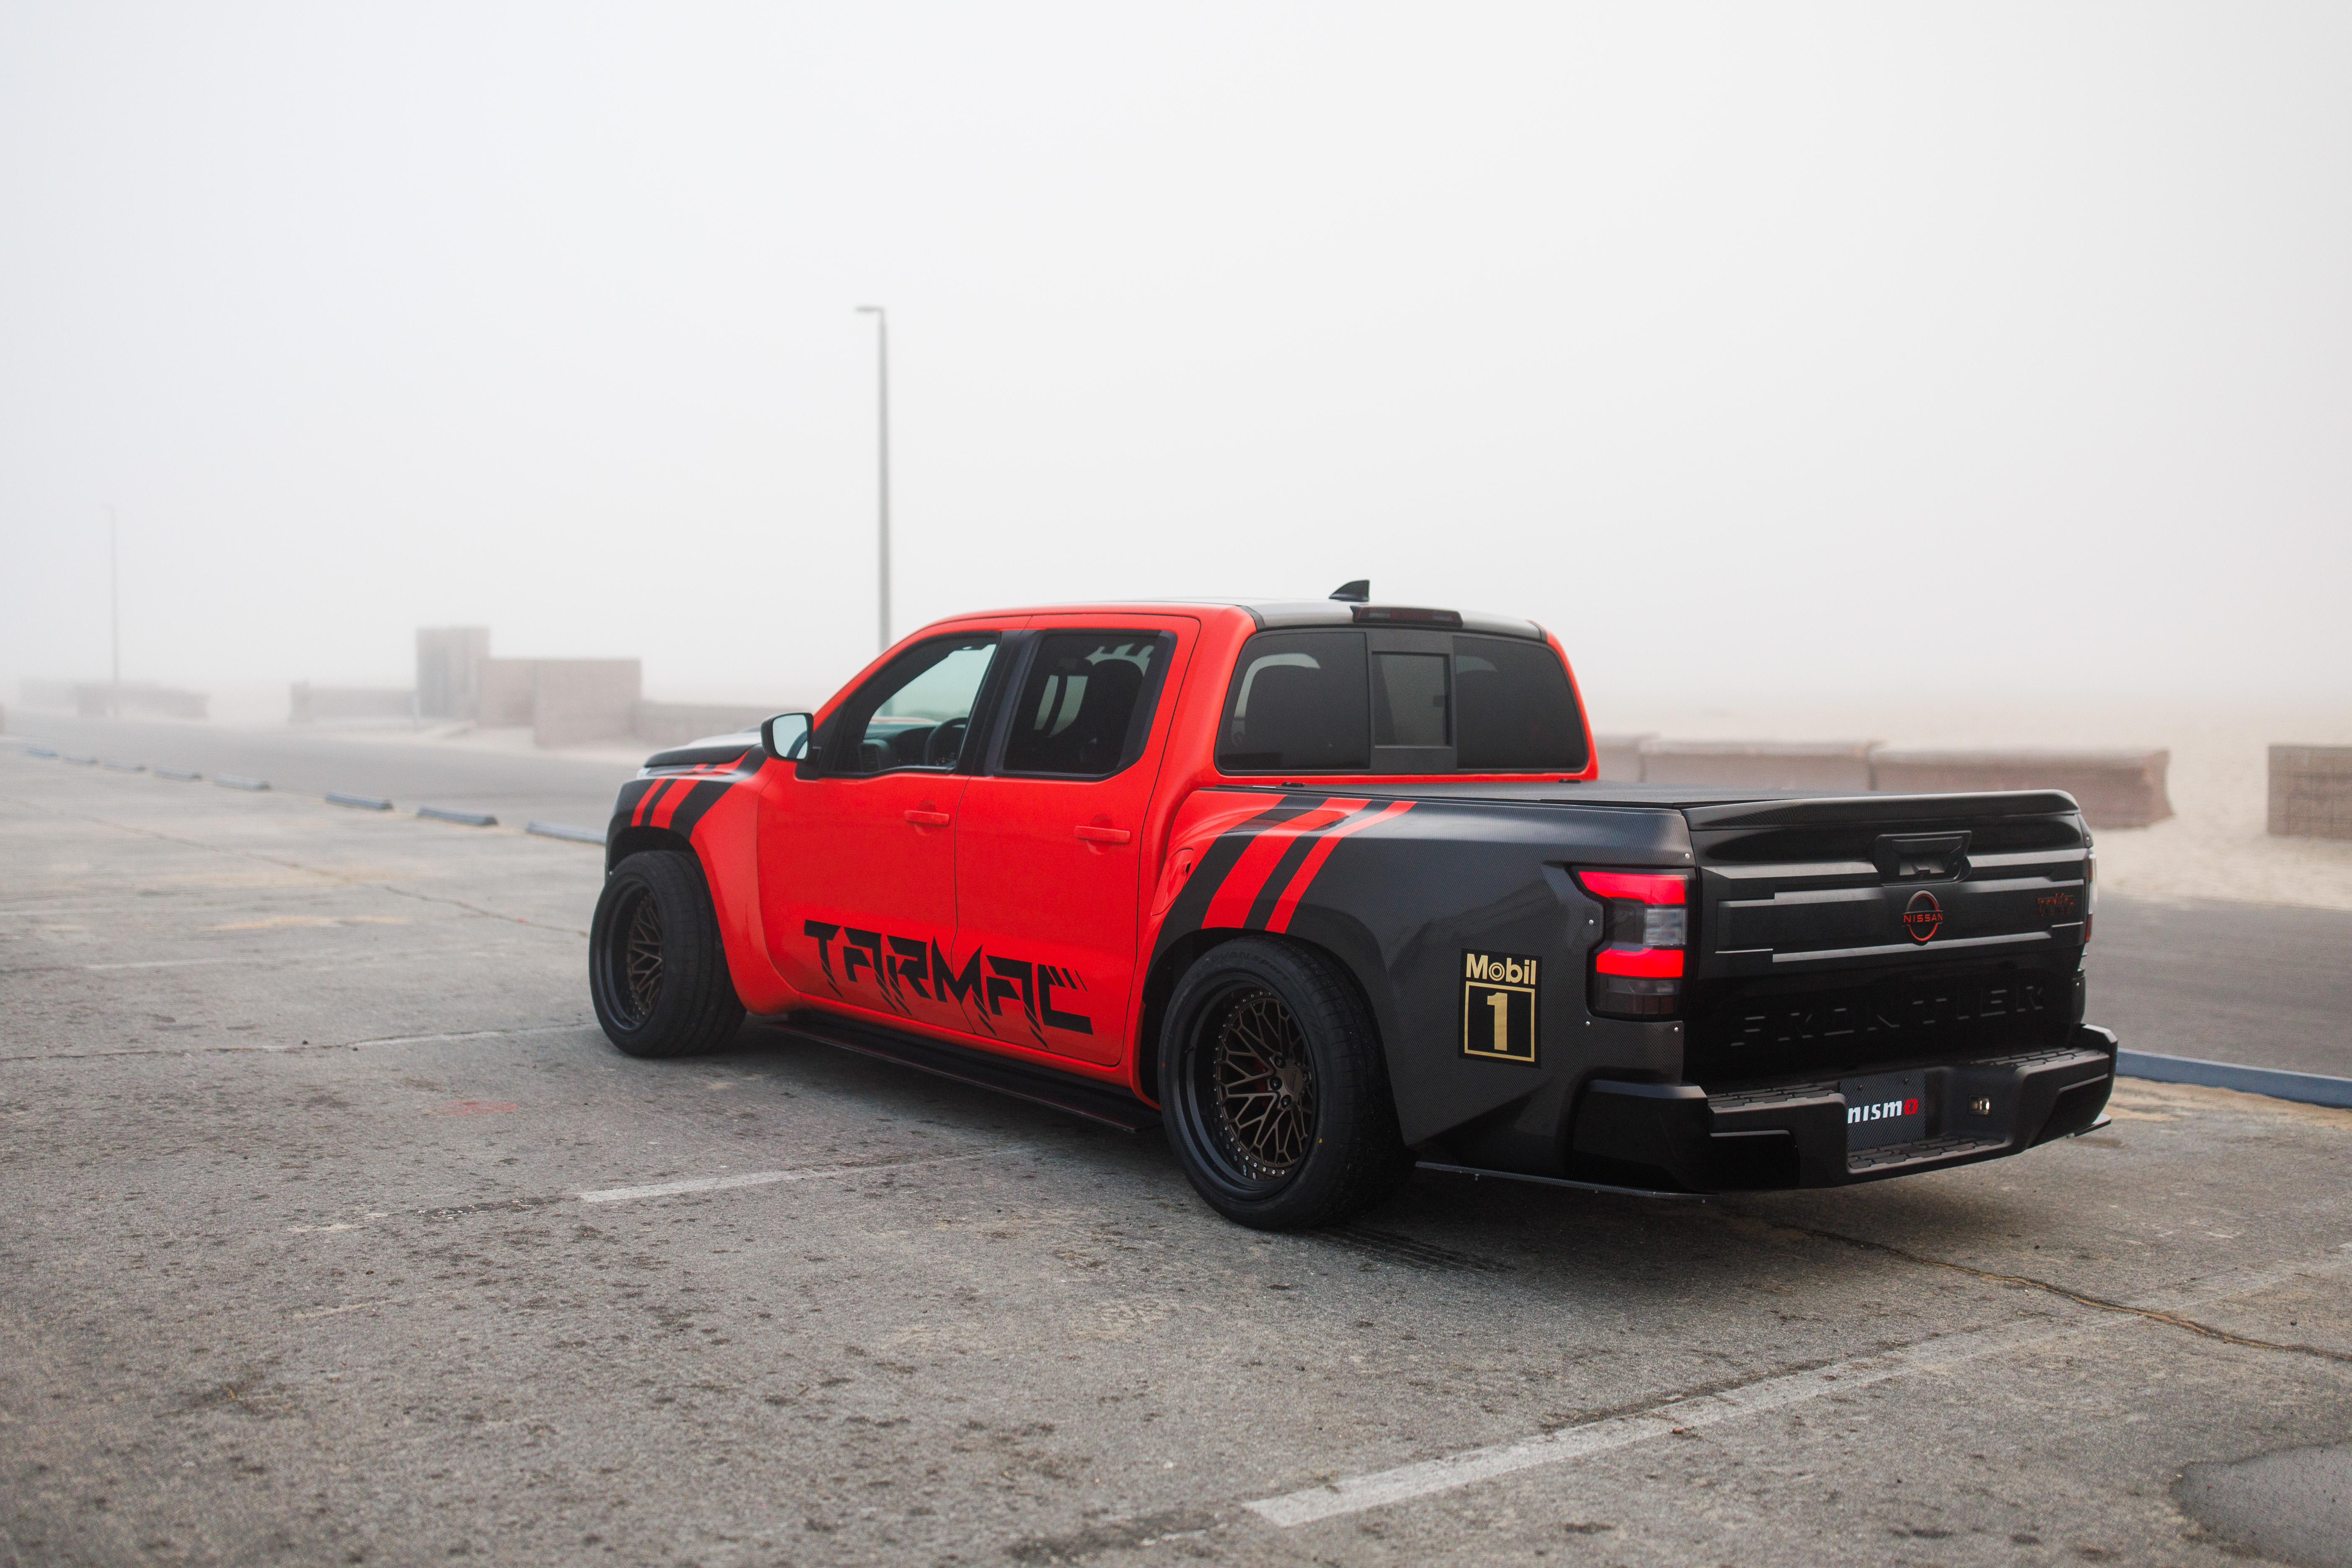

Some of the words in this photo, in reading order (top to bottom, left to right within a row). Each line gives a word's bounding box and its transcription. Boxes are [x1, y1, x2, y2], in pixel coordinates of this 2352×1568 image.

[1903, 913, 1943, 922] NISSAN
[804, 919, 1094, 1049] TARMAC
[1466, 953, 1536, 985] Mobil
[1487, 992, 1508, 1051] 1
